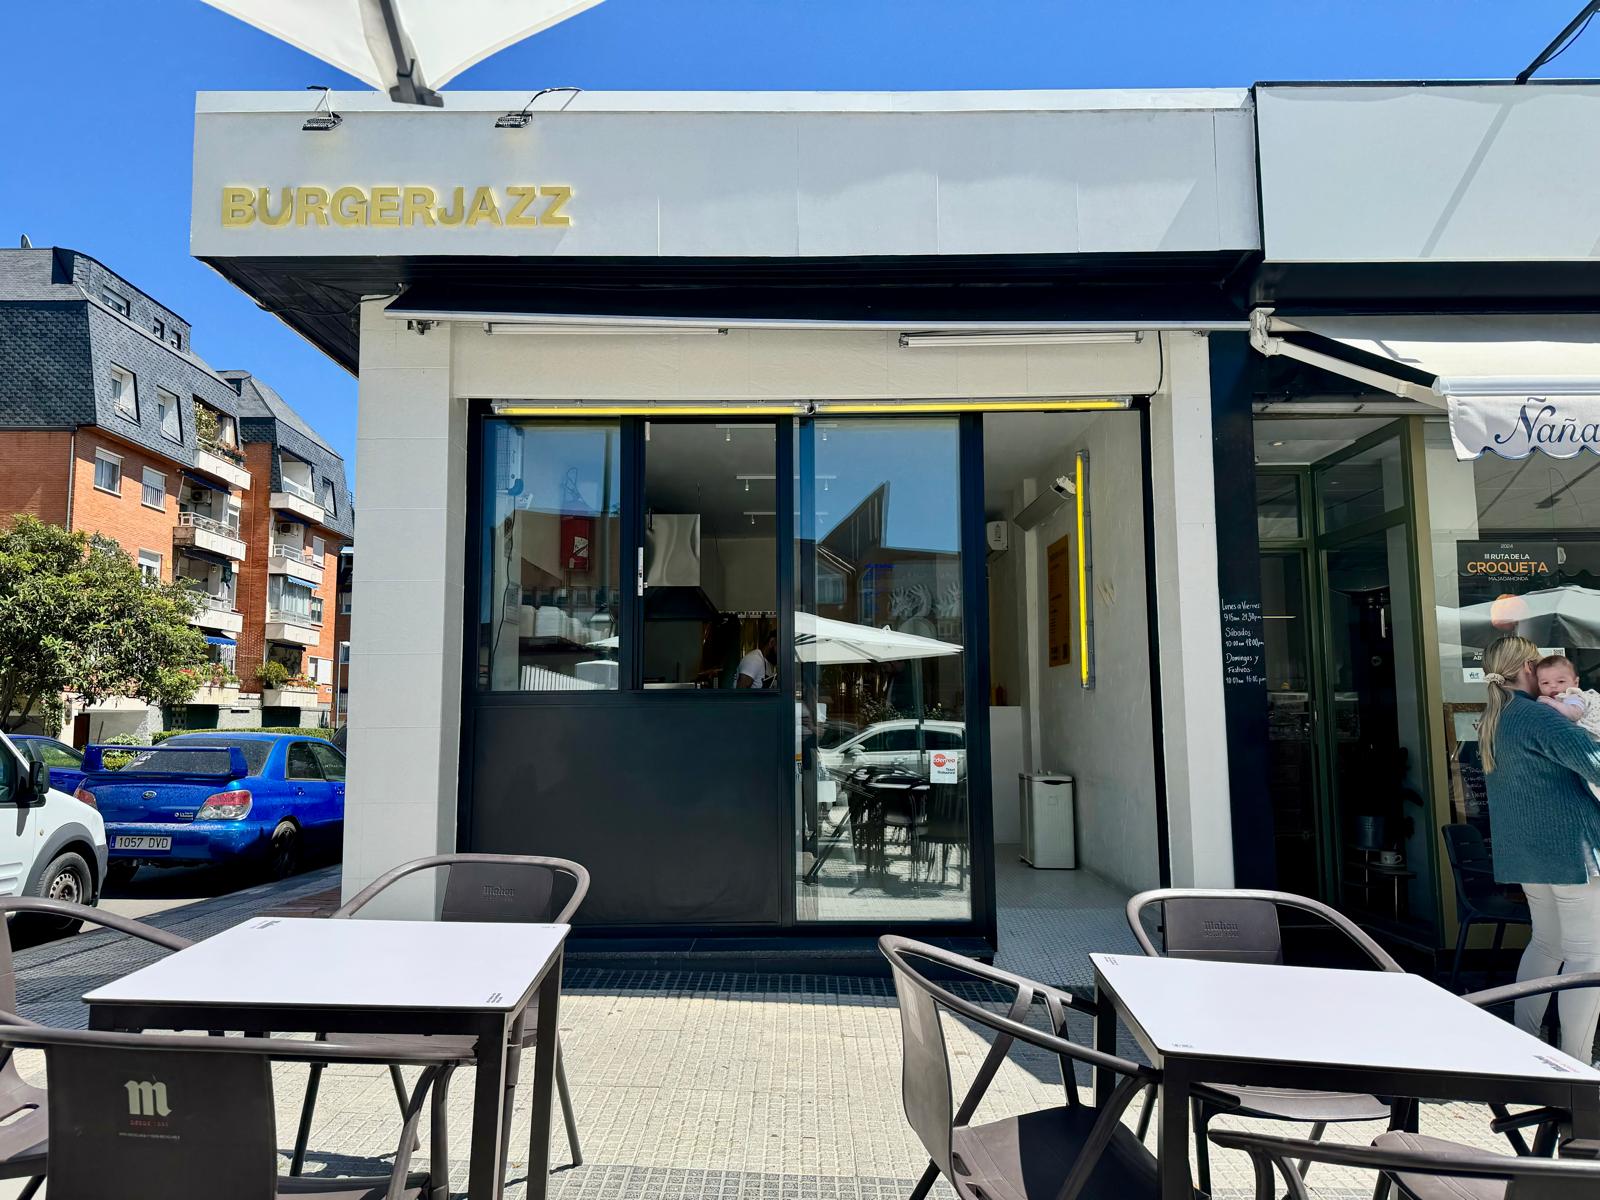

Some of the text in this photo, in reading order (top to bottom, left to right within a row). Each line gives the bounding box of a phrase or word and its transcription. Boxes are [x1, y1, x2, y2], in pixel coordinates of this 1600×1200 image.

[221, 185, 574, 227] BURGERJAZZ
[1494, 396, 1600, 444] Ñaña
[1466, 561, 1549, 575] CROQUETA
[119, 837, 168, 848] 1057 DVD
